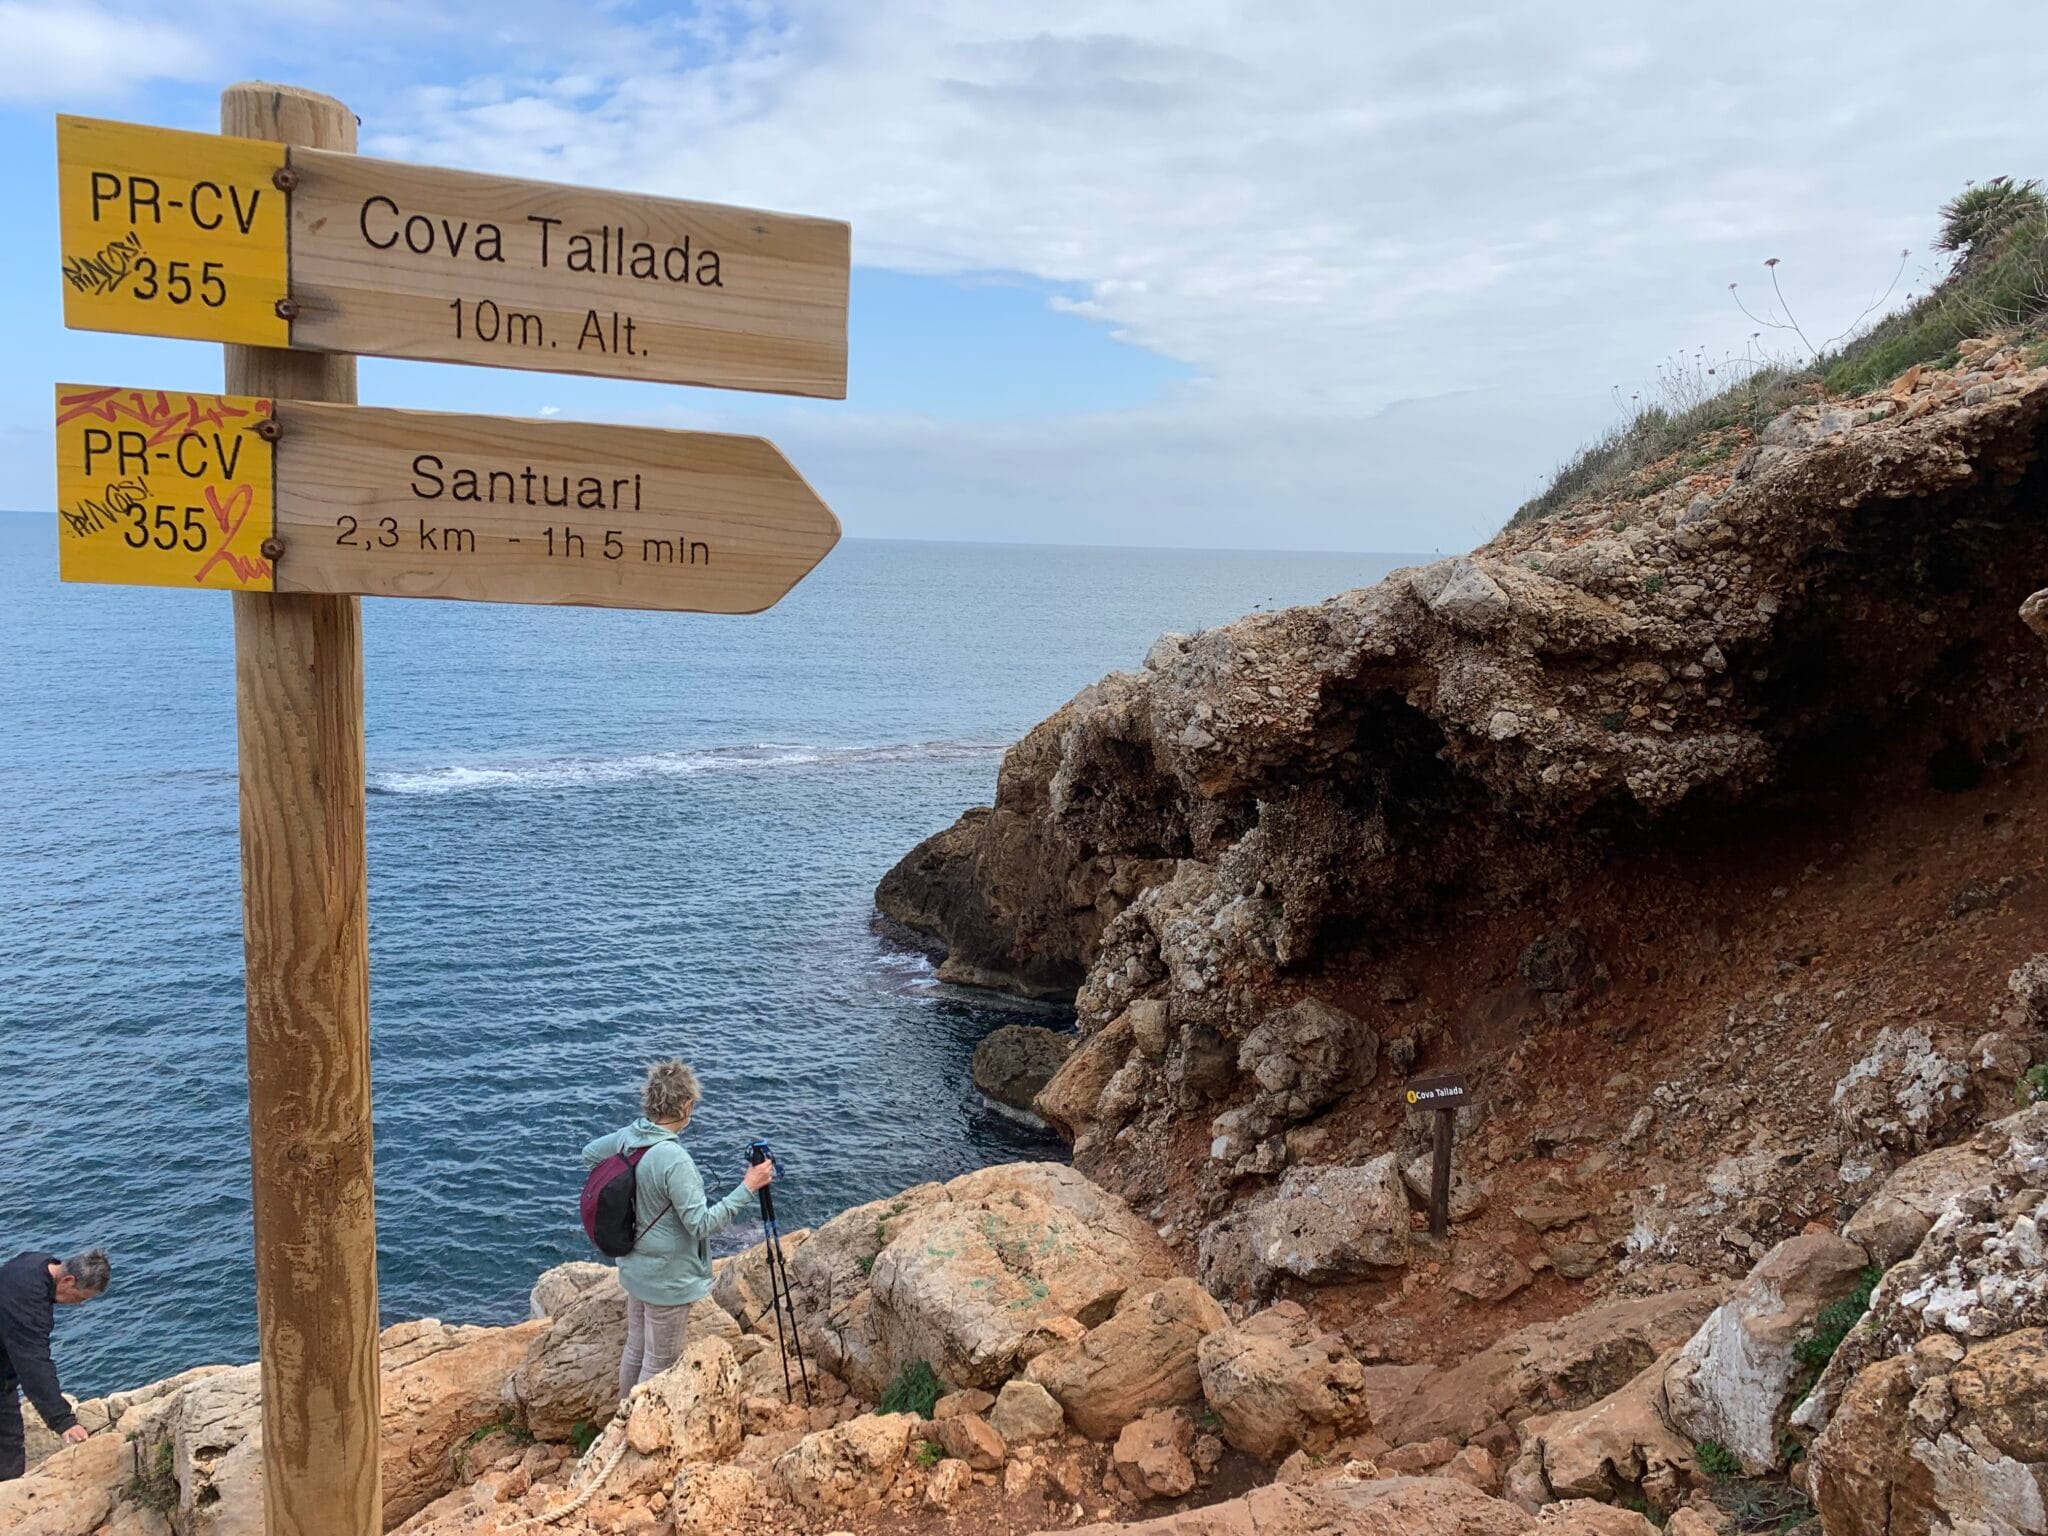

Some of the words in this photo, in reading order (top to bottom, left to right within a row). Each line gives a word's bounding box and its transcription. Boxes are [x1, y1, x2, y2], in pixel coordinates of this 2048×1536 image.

[91, 171, 260, 234] PR-CV
[360, 195, 505, 263] Cova
[527, 215, 723, 287] Tallada
[133, 257, 226, 307] 355
[449, 297, 556, 347] 10m.
[577, 309, 648, 357] Alt.
[84, 428, 242, 480] PR-CV
[410, 454, 640, 511] Santuari
[124, 503, 207, 552] 355
[336, 515, 399, 551] 2,3
[418, 518, 475, 552] km
[542, 526, 585, 558] 1h
[603, 530, 624, 560] 5
[642, 536, 709, 565] min
[1415, 1090, 1434, 1100] Cova
[1435, 1086, 1463, 1097] Tallada
